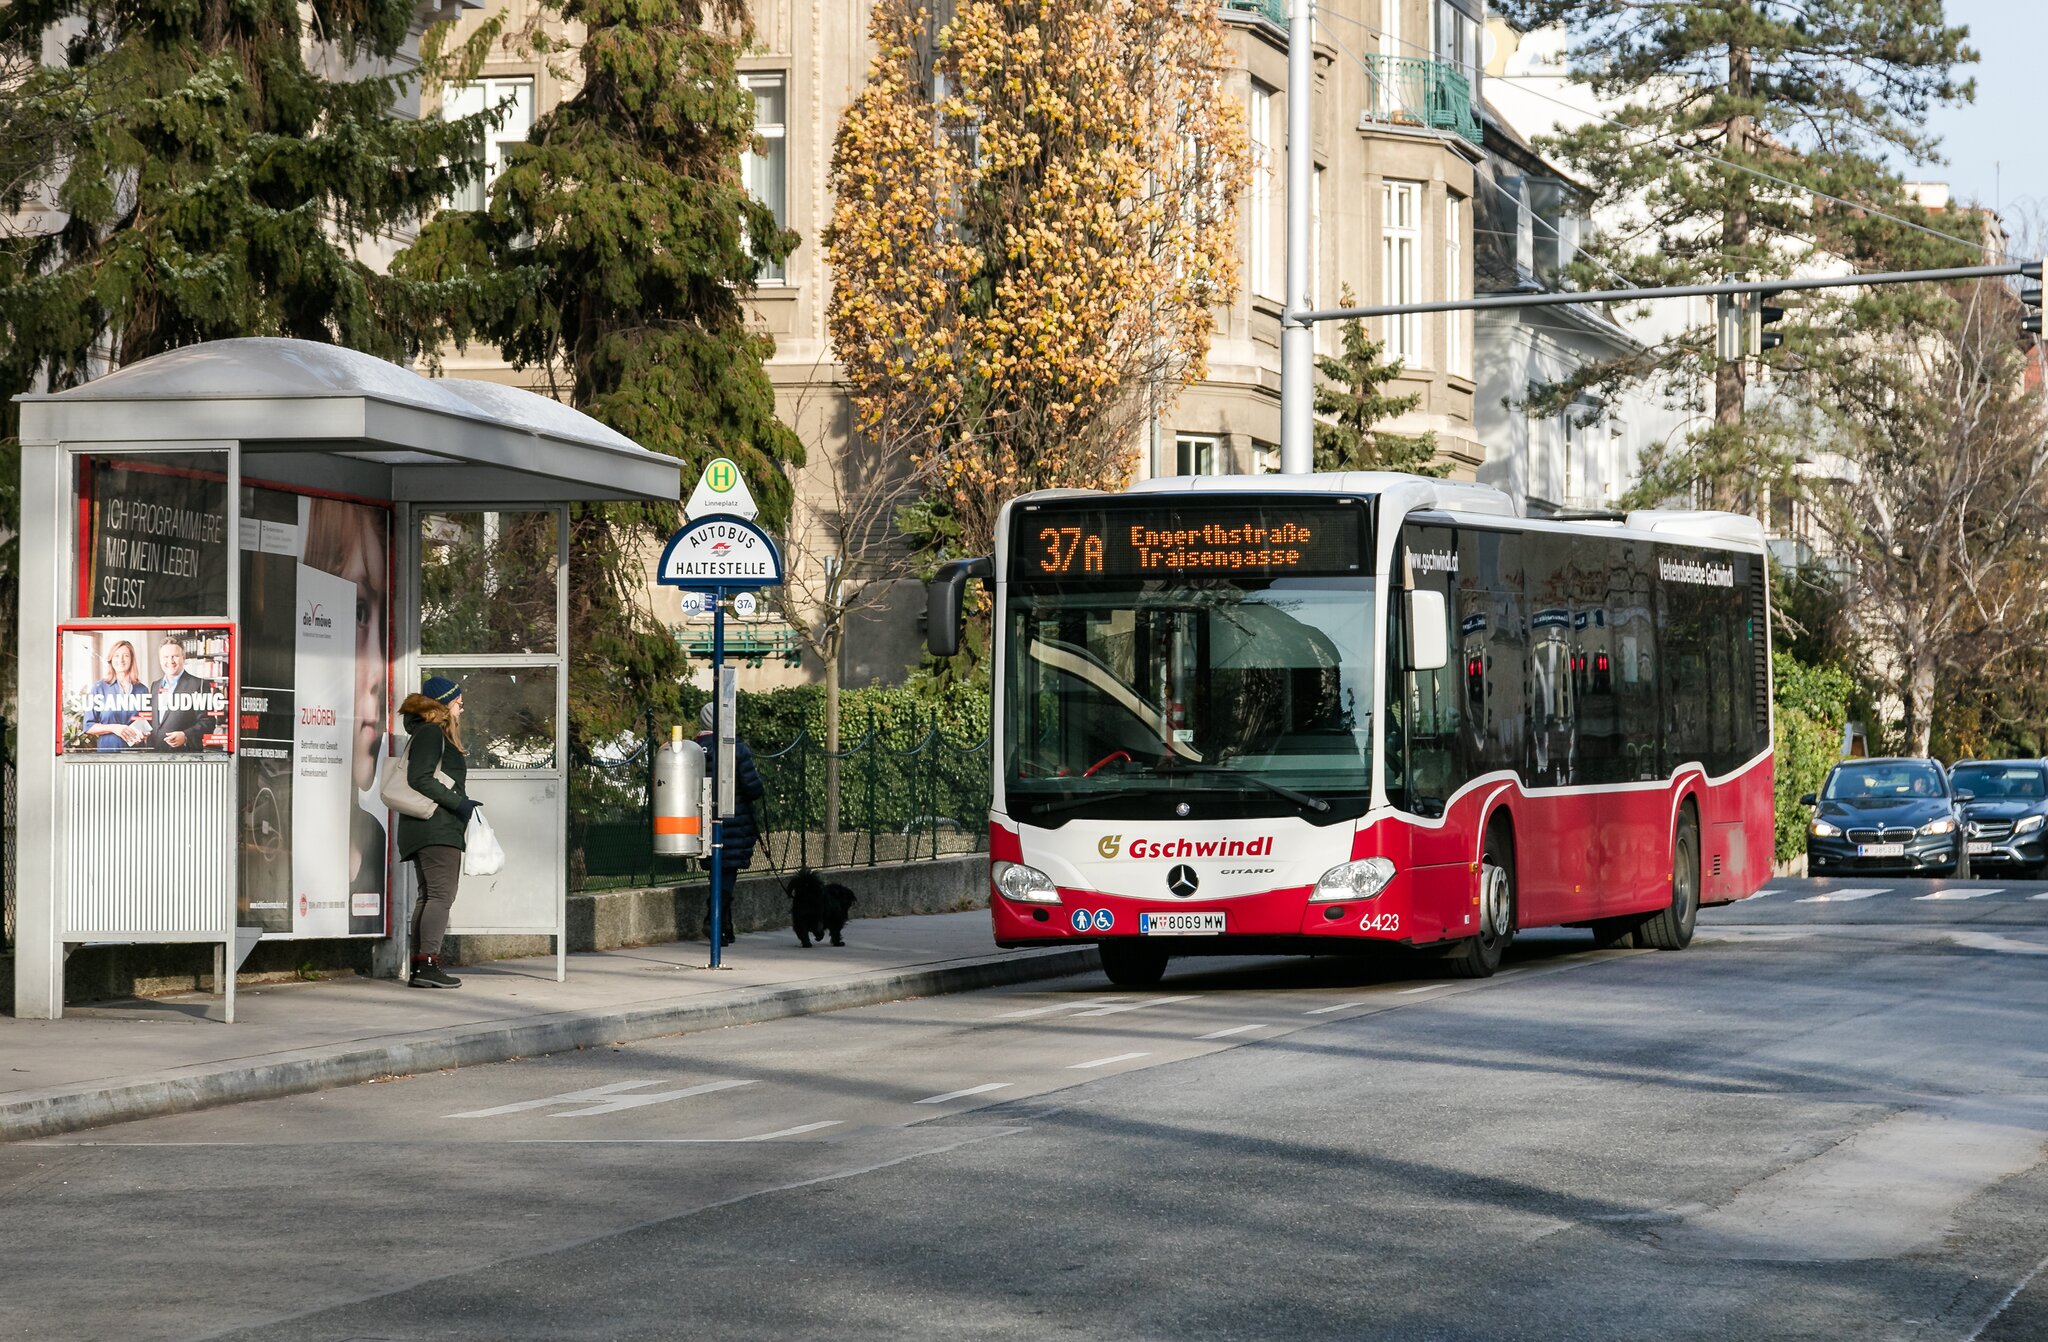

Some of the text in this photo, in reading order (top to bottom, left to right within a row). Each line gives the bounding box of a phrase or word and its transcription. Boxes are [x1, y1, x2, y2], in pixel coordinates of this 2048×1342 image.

[714, 466, 729, 486] H
[704, 500, 738, 509] Linneplatz
[106, 498, 129, 530] ICH
[131, 502, 222, 544] PROGRAMMIERE
[690, 525, 756, 549] AUTOBUS
[1131, 523, 1311, 548] Engerthstraße
[105, 537, 199, 579] MIR MEIN LEBEN
[1040, 527, 1103, 572] 37A
[1139, 547, 1300, 569] Traisengasse
[676, 562, 766, 575] HALTESTELLE
[1659, 557, 1734, 588] Verkehrsbetriebe Gschwindl
[102, 575, 146, 610] SELBST.
[737, 599, 753, 609] 37A
[303, 612, 332, 628] die möwe
[70, 691, 225, 712] SUSANNE LUDWIG
[301, 705, 336, 727] ZUHÖREN
[1128, 836, 1274, 859] Gschwindl
[1149, 916, 1158, 929] W
[1168, 915, 1200, 929] 8069
[1204, 915, 1223, 929] MW
[1359, 913, 1400, 932] 6423
